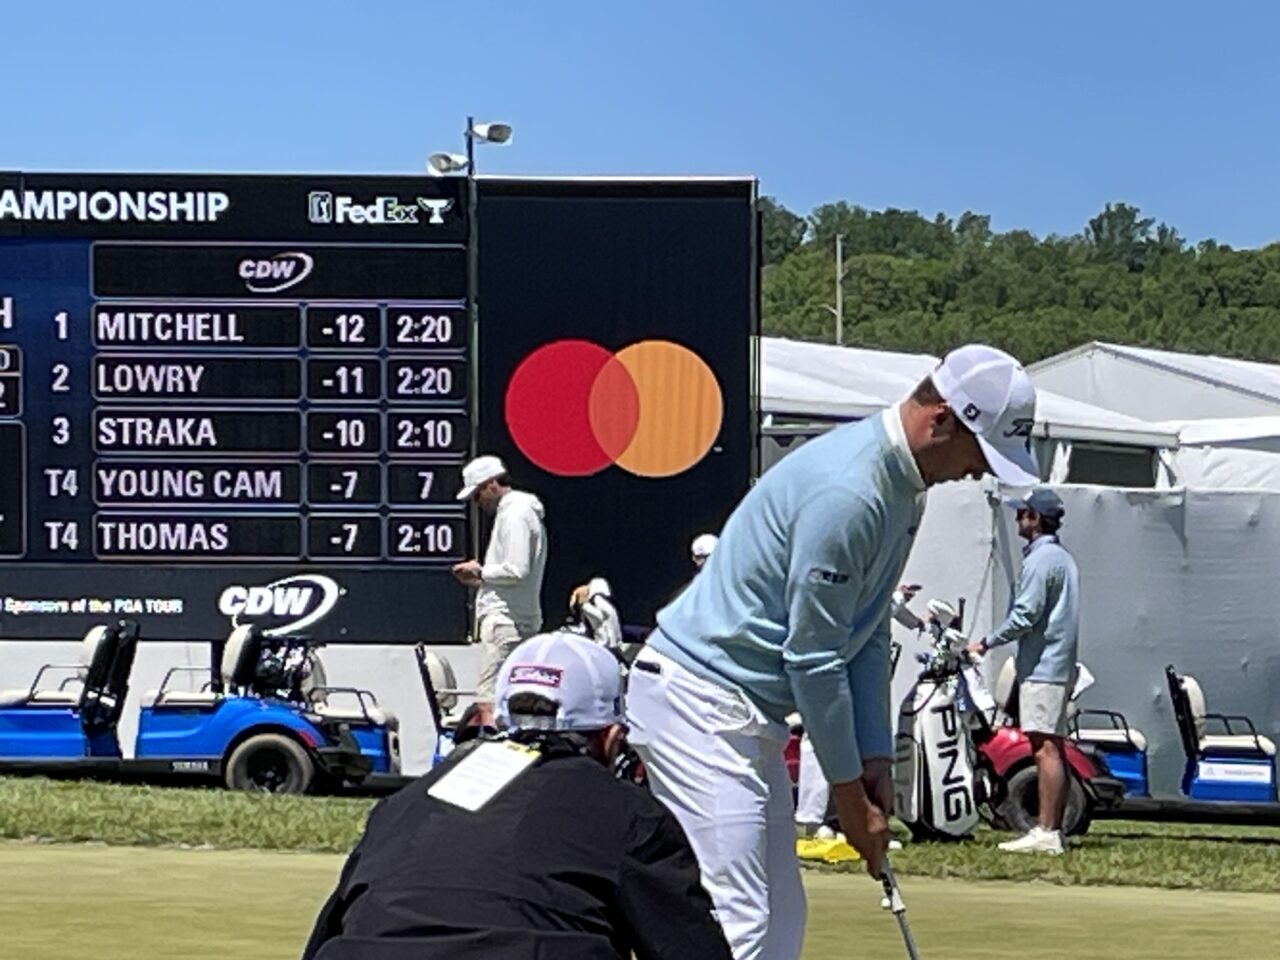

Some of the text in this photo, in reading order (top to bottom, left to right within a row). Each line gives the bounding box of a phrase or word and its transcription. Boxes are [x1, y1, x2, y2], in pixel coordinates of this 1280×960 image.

[0, 190, 229, 222] AMPIONSHIP
[335, 196, 418, 224] FedEx
[54, 312, 452, 343] 1 MITCHELL -12 2:20
[52, 364, 452, 395] 2 LOWRY -11 2:20
[52, 417, 452, 447] 3 STRAKA -10 2:10
[44, 469, 434, 499] T4 YOUNG CAM -7 7
[44, 521, 453, 552] T4 THOMAS -7 2:10
[71, 599, 87, 614] of
[114, 599, 143, 614] PGA
[218, 585, 314, 616] CDW
[930, 703, 972, 822] PING
